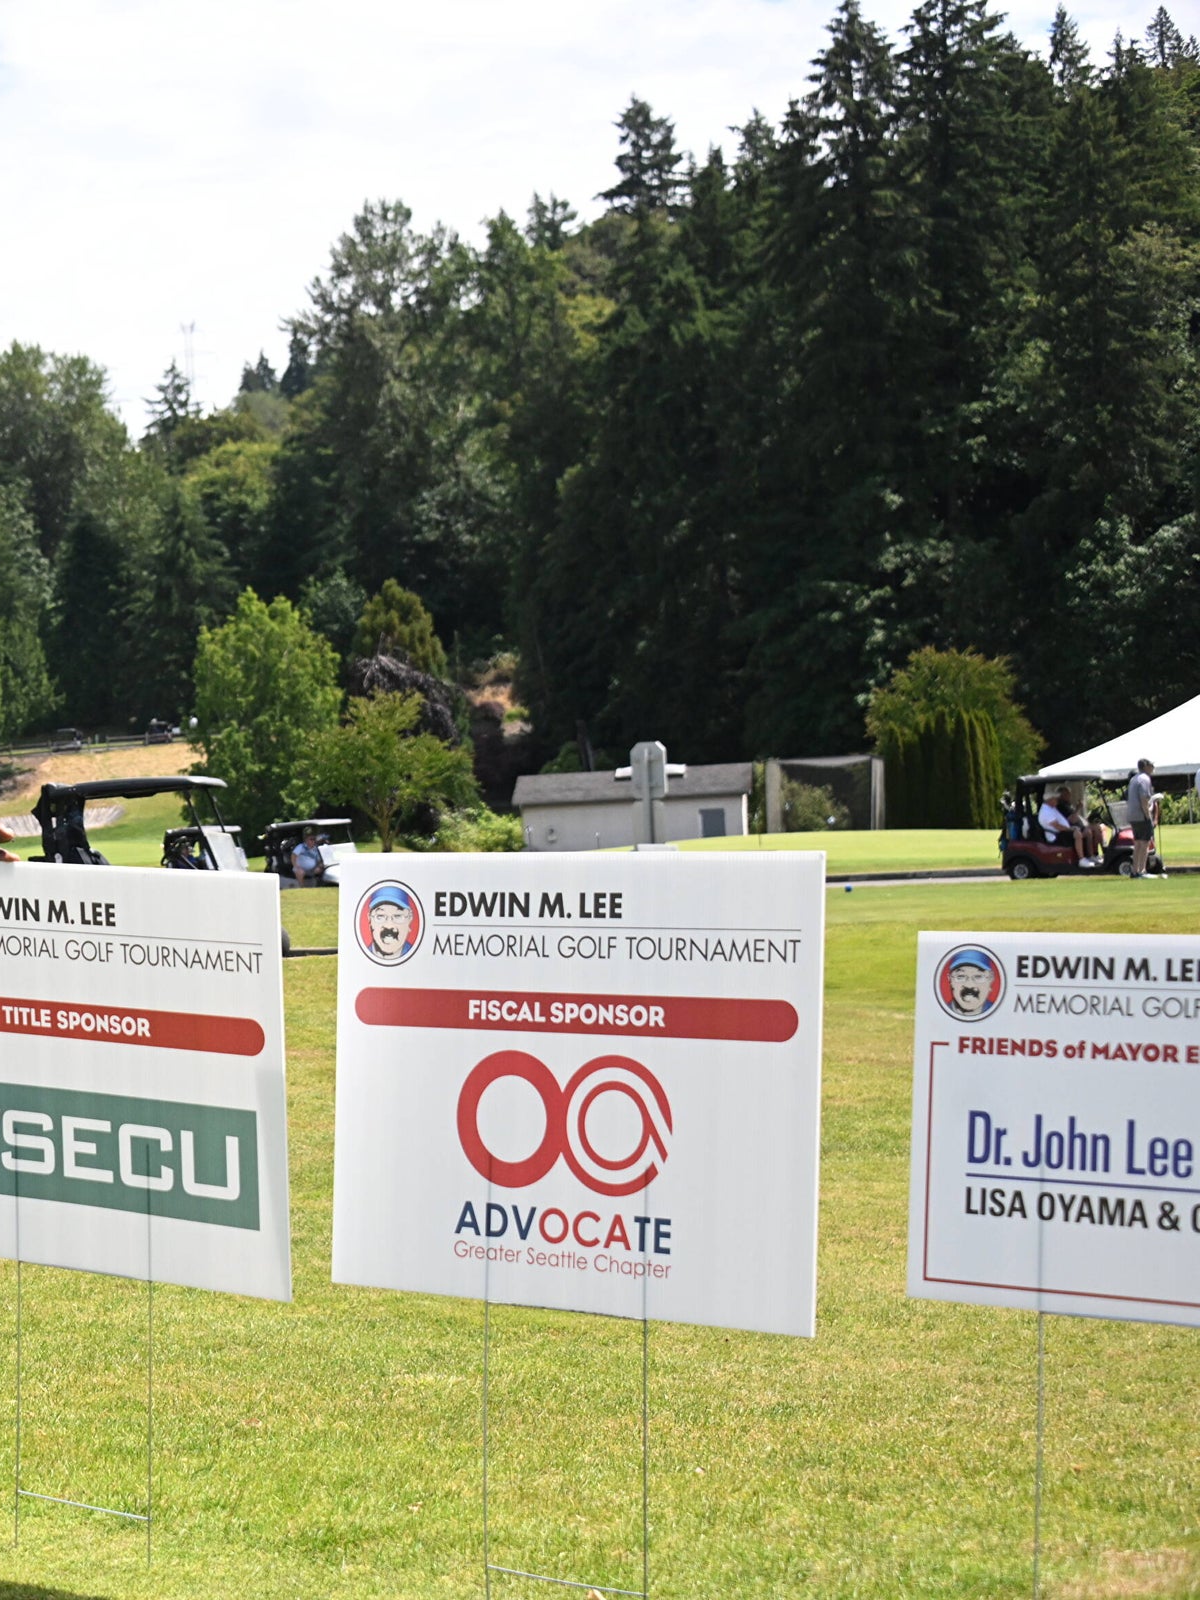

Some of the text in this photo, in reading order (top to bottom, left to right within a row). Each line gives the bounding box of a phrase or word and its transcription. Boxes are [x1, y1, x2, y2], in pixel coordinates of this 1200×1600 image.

[48, 900, 75, 925] M.
[80, 901, 116, 927] LEE
[434, 892, 623, 919] EDWIN M. LEE
[65, 940, 114, 963] GOLF
[120, 943, 263, 974] TOURNAMENT
[432, 933, 801, 963] MEMORIAL GOLF TOURNAMENT
[1016, 955, 1200, 982] EDWIN M. LE
[468, 999, 665, 1027] FISCAL SPONSOR
[1014, 993, 1133, 1017] MEMORIAL
[2, 1005, 151, 1037] TITLE SPONSOR
[958, 1036, 1057, 1058] FRIENDS
[1063, 1041, 1086, 1059] of
[1091, 1042, 1178, 1063] MAYOR
[967, 1110, 1192, 1178] Dr. John Lee
[965, 1186, 1027, 1219] LISA
[1037, 1192, 1148, 1228] OYAMA
[1158, 1201, 1180, 1231] &
[454, 1201, 672, 1255] ADVOCATE
[453, 1240, 672, 1280] Greater Seattle Chapter
